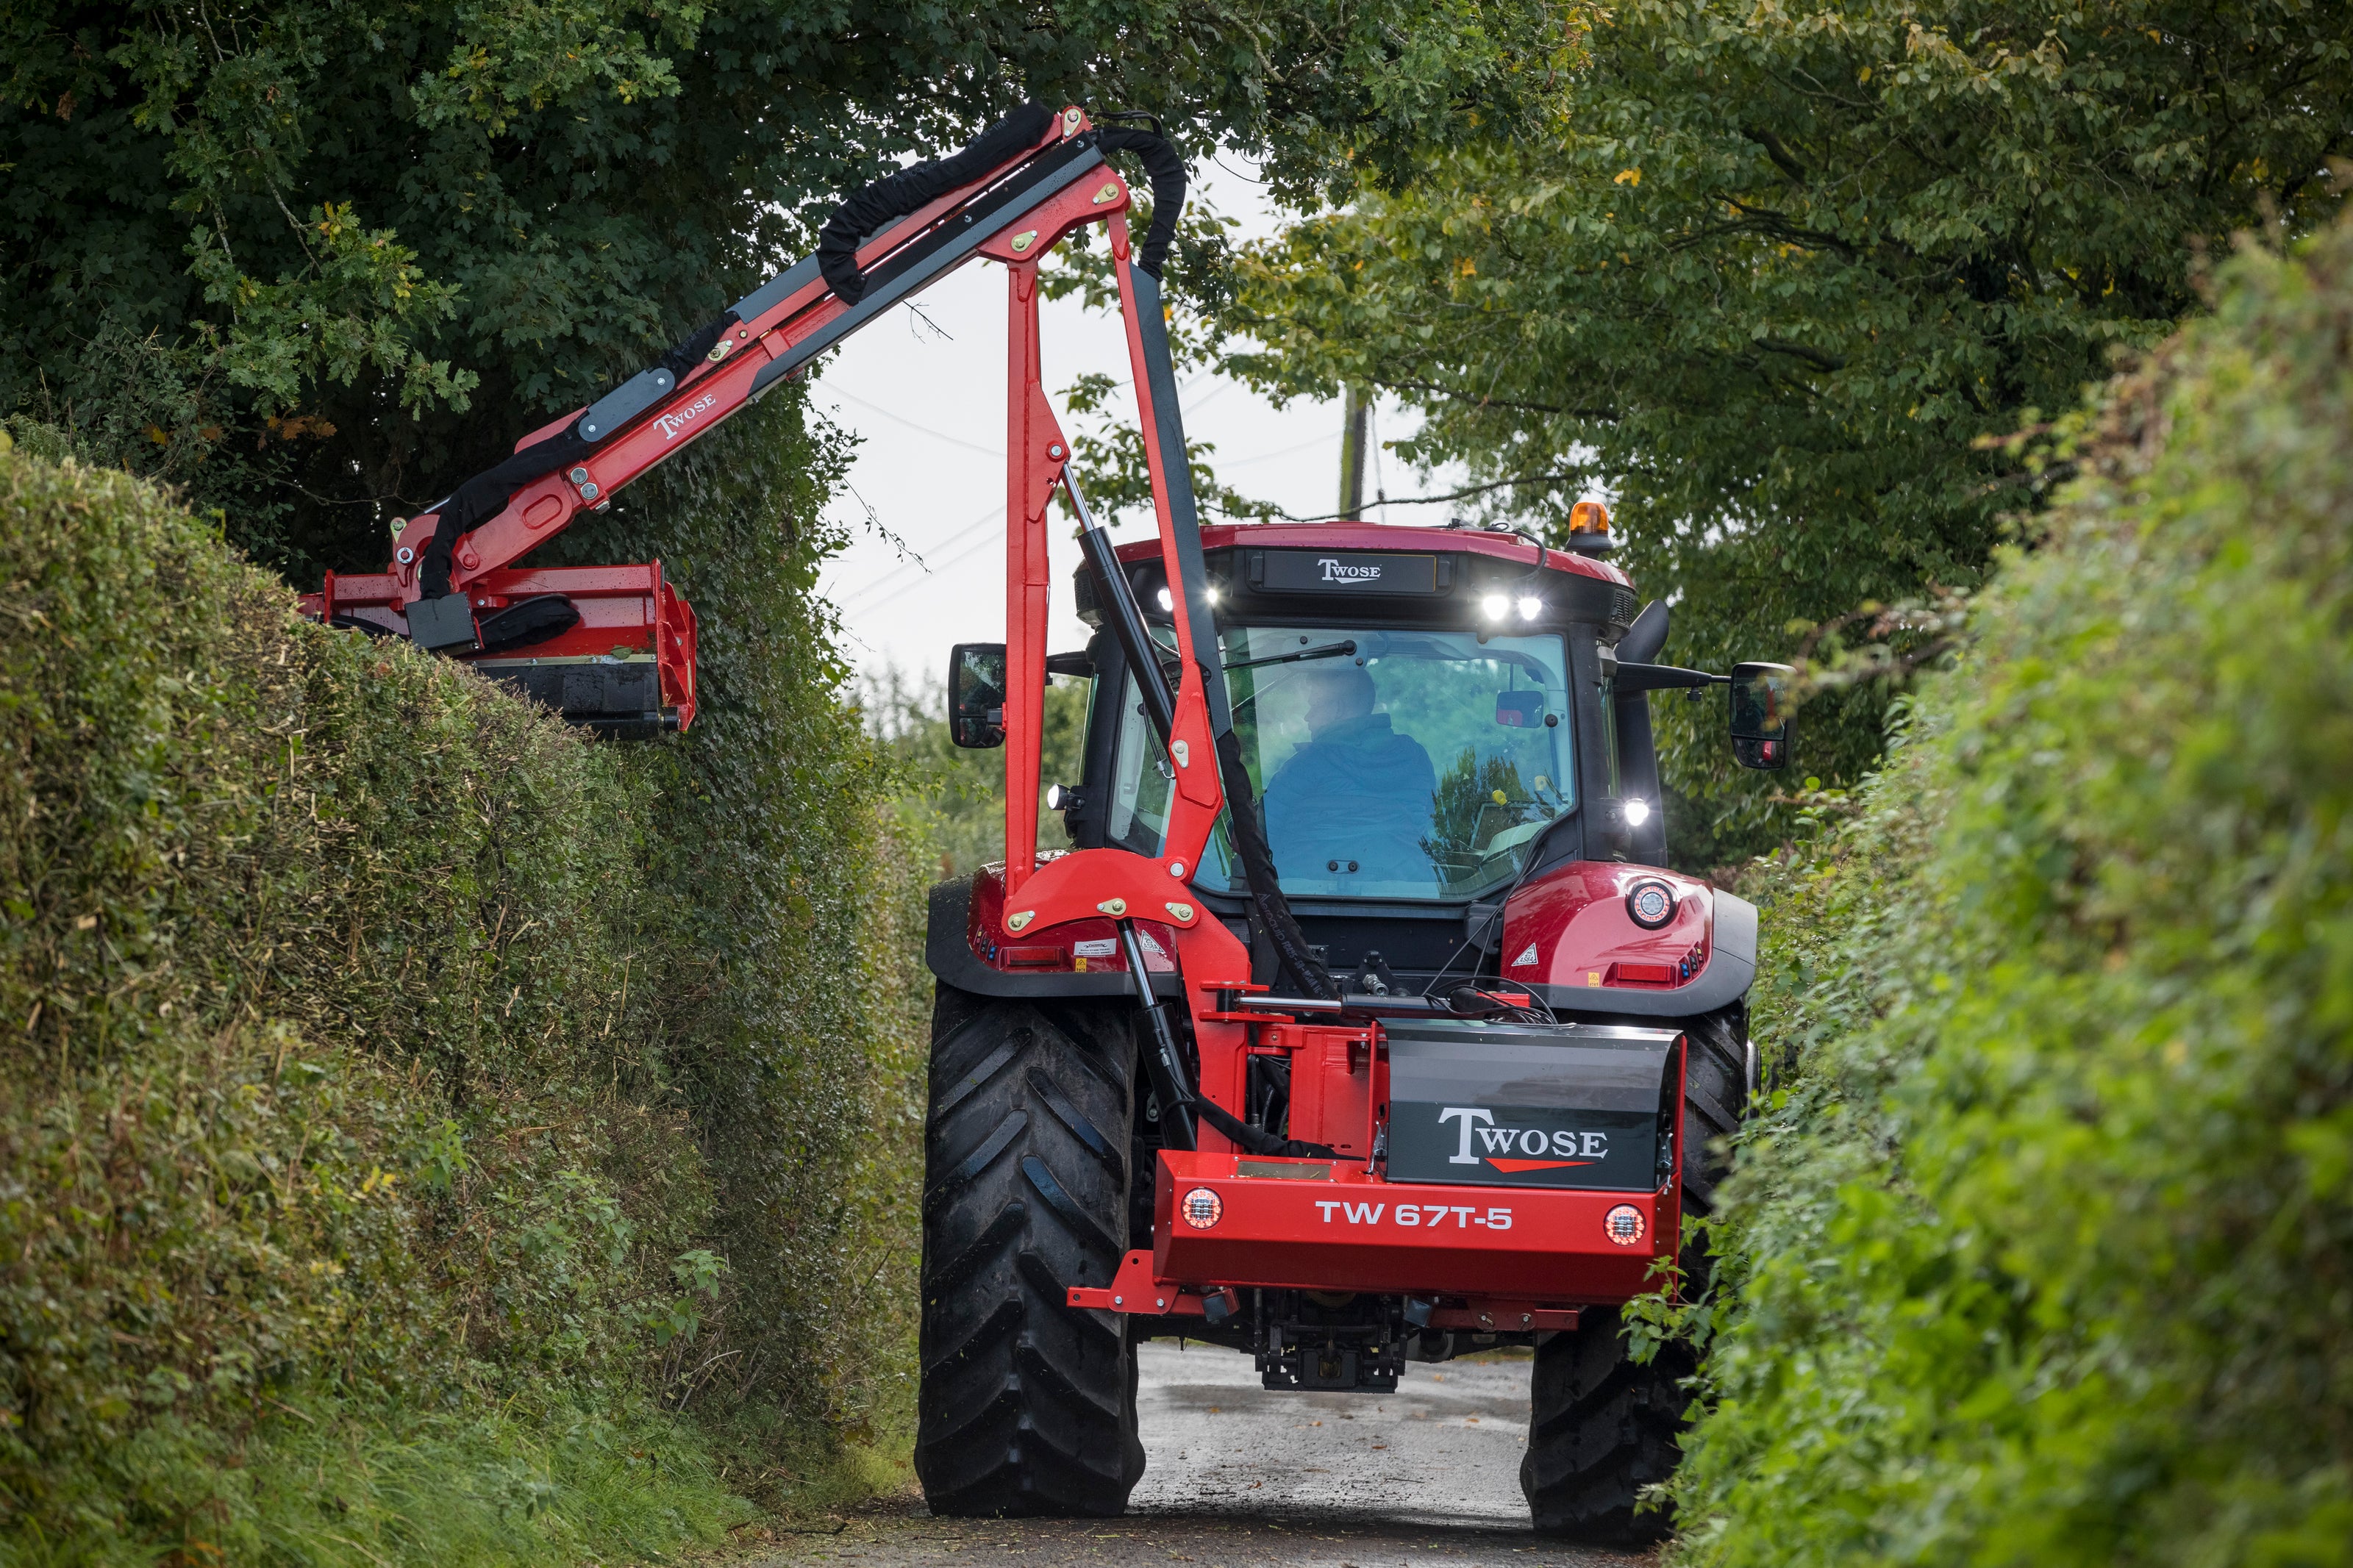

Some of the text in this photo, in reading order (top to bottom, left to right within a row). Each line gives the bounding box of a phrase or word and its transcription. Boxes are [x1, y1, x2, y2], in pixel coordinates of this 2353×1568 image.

[1256, 893, 1285, 944] Aeroquip
[1315, 1200, 1513, 1230] TW 67T-5
